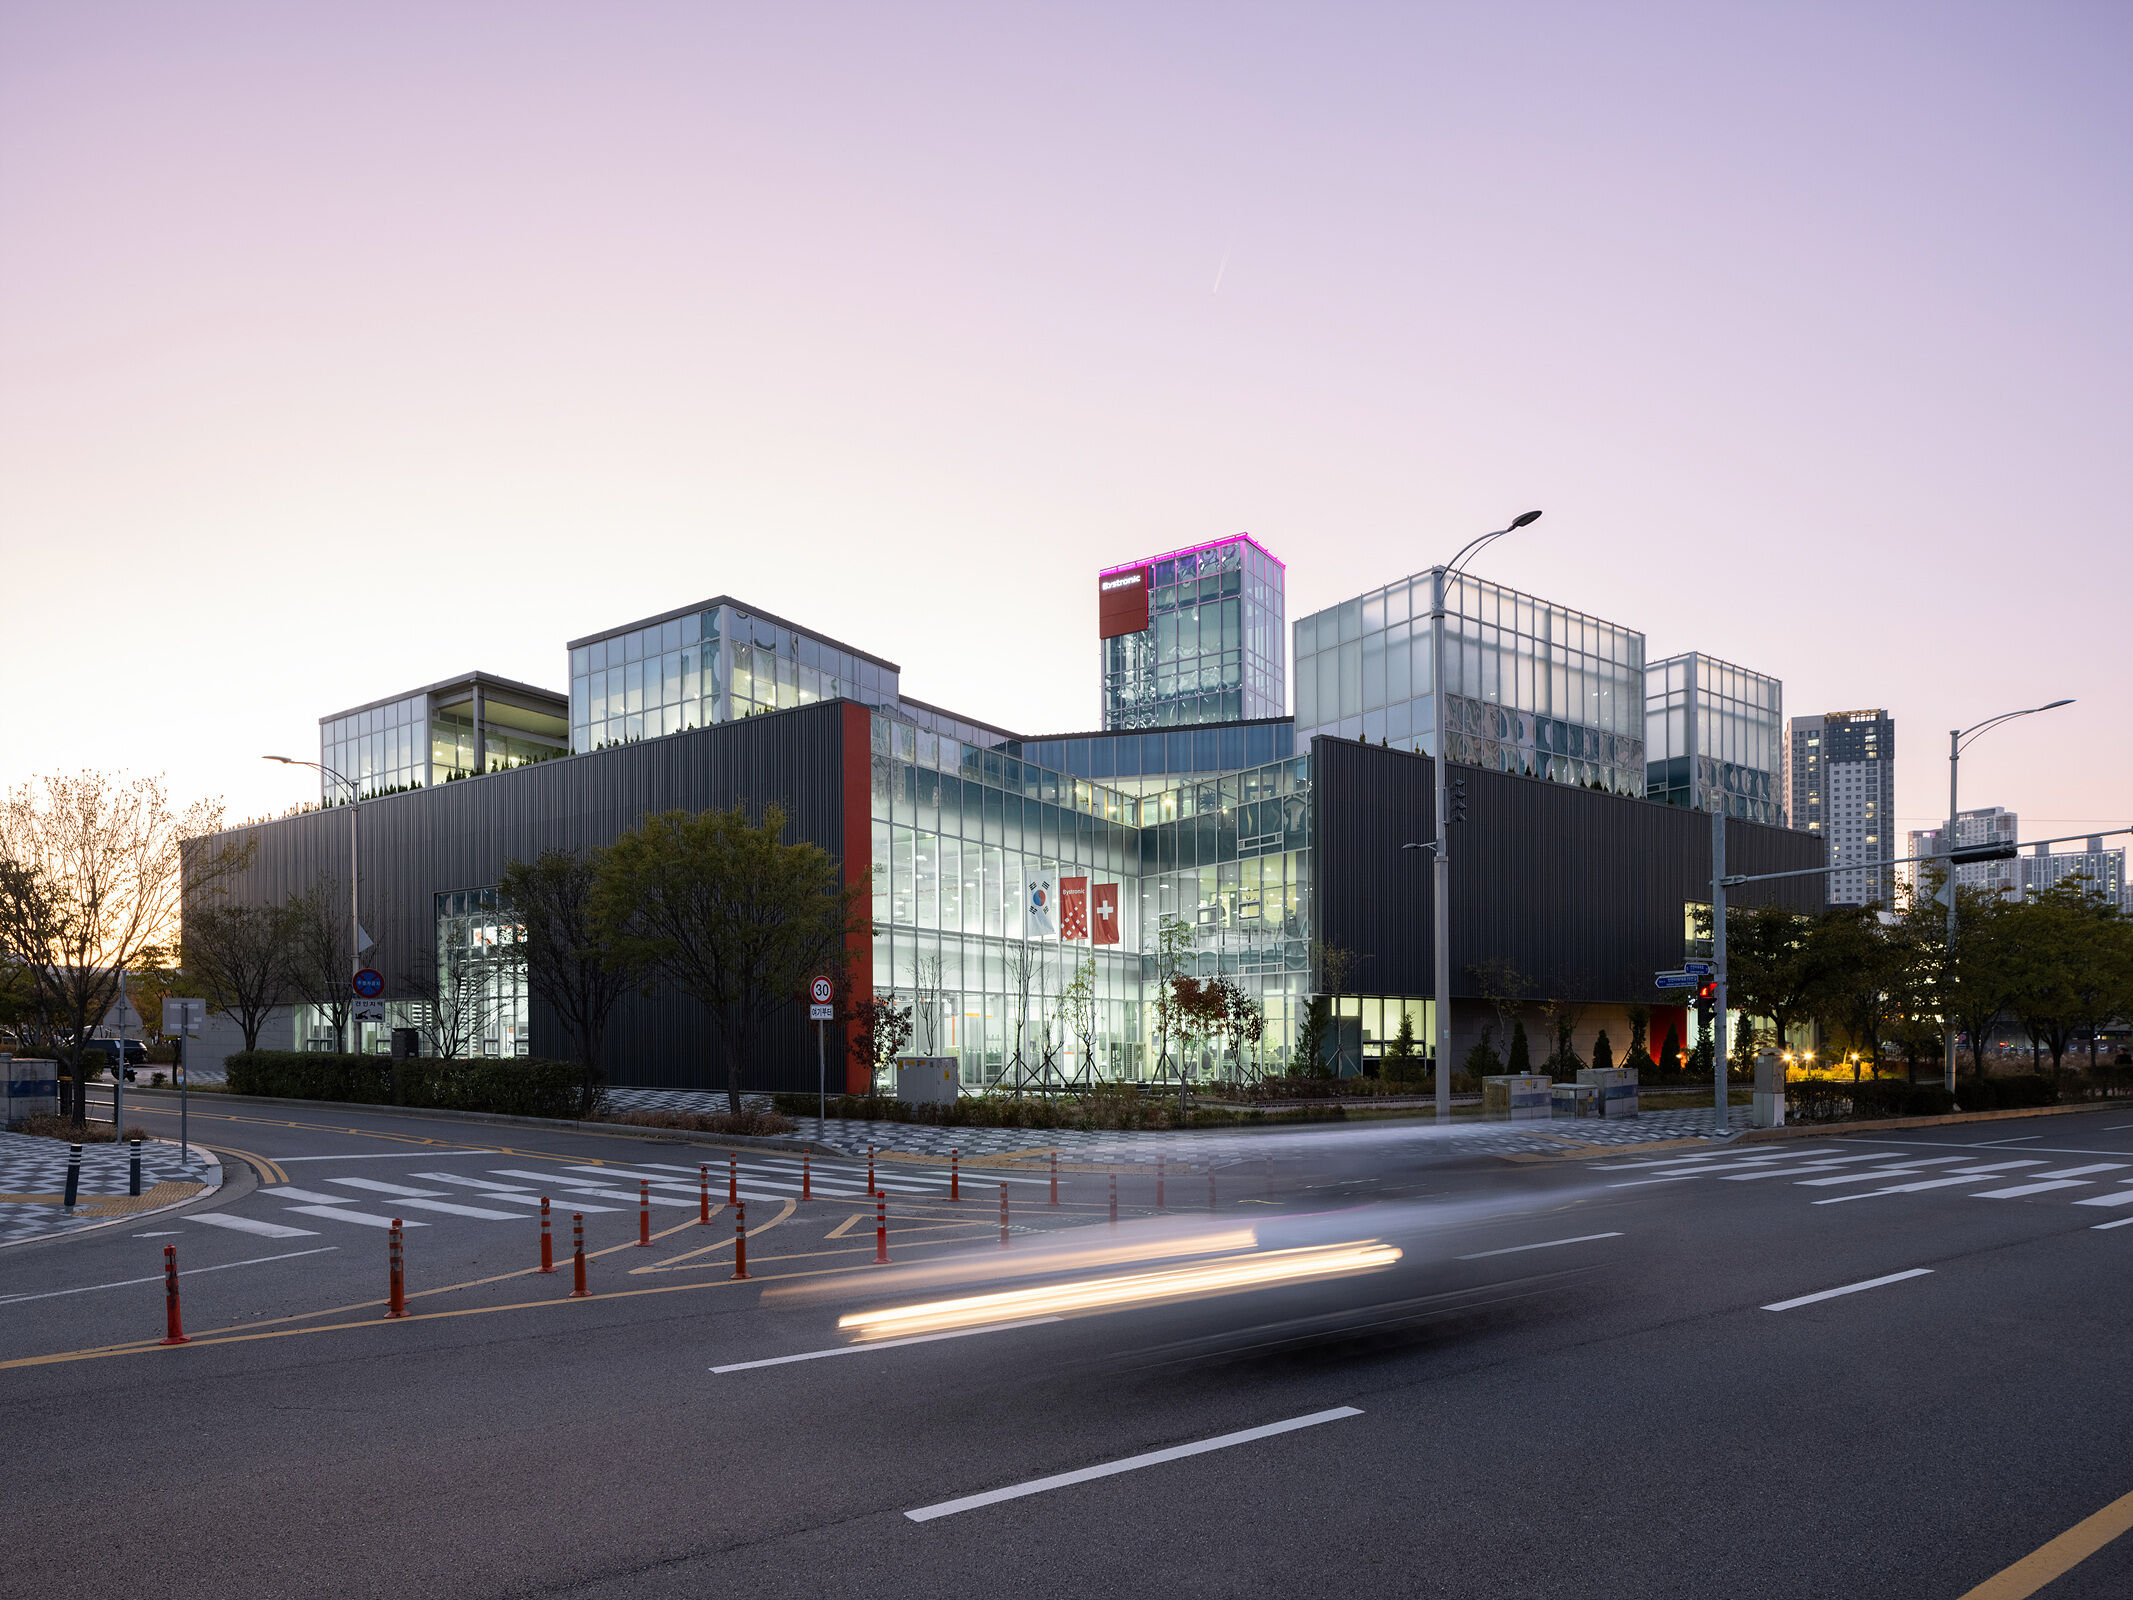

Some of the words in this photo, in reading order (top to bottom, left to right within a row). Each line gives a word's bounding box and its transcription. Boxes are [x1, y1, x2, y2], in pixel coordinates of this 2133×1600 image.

[1102, 575, 1141, 591] Bystronic
[815, 984, 829, 996] 30
[811, 1007, 832, 1016] 여기부터
